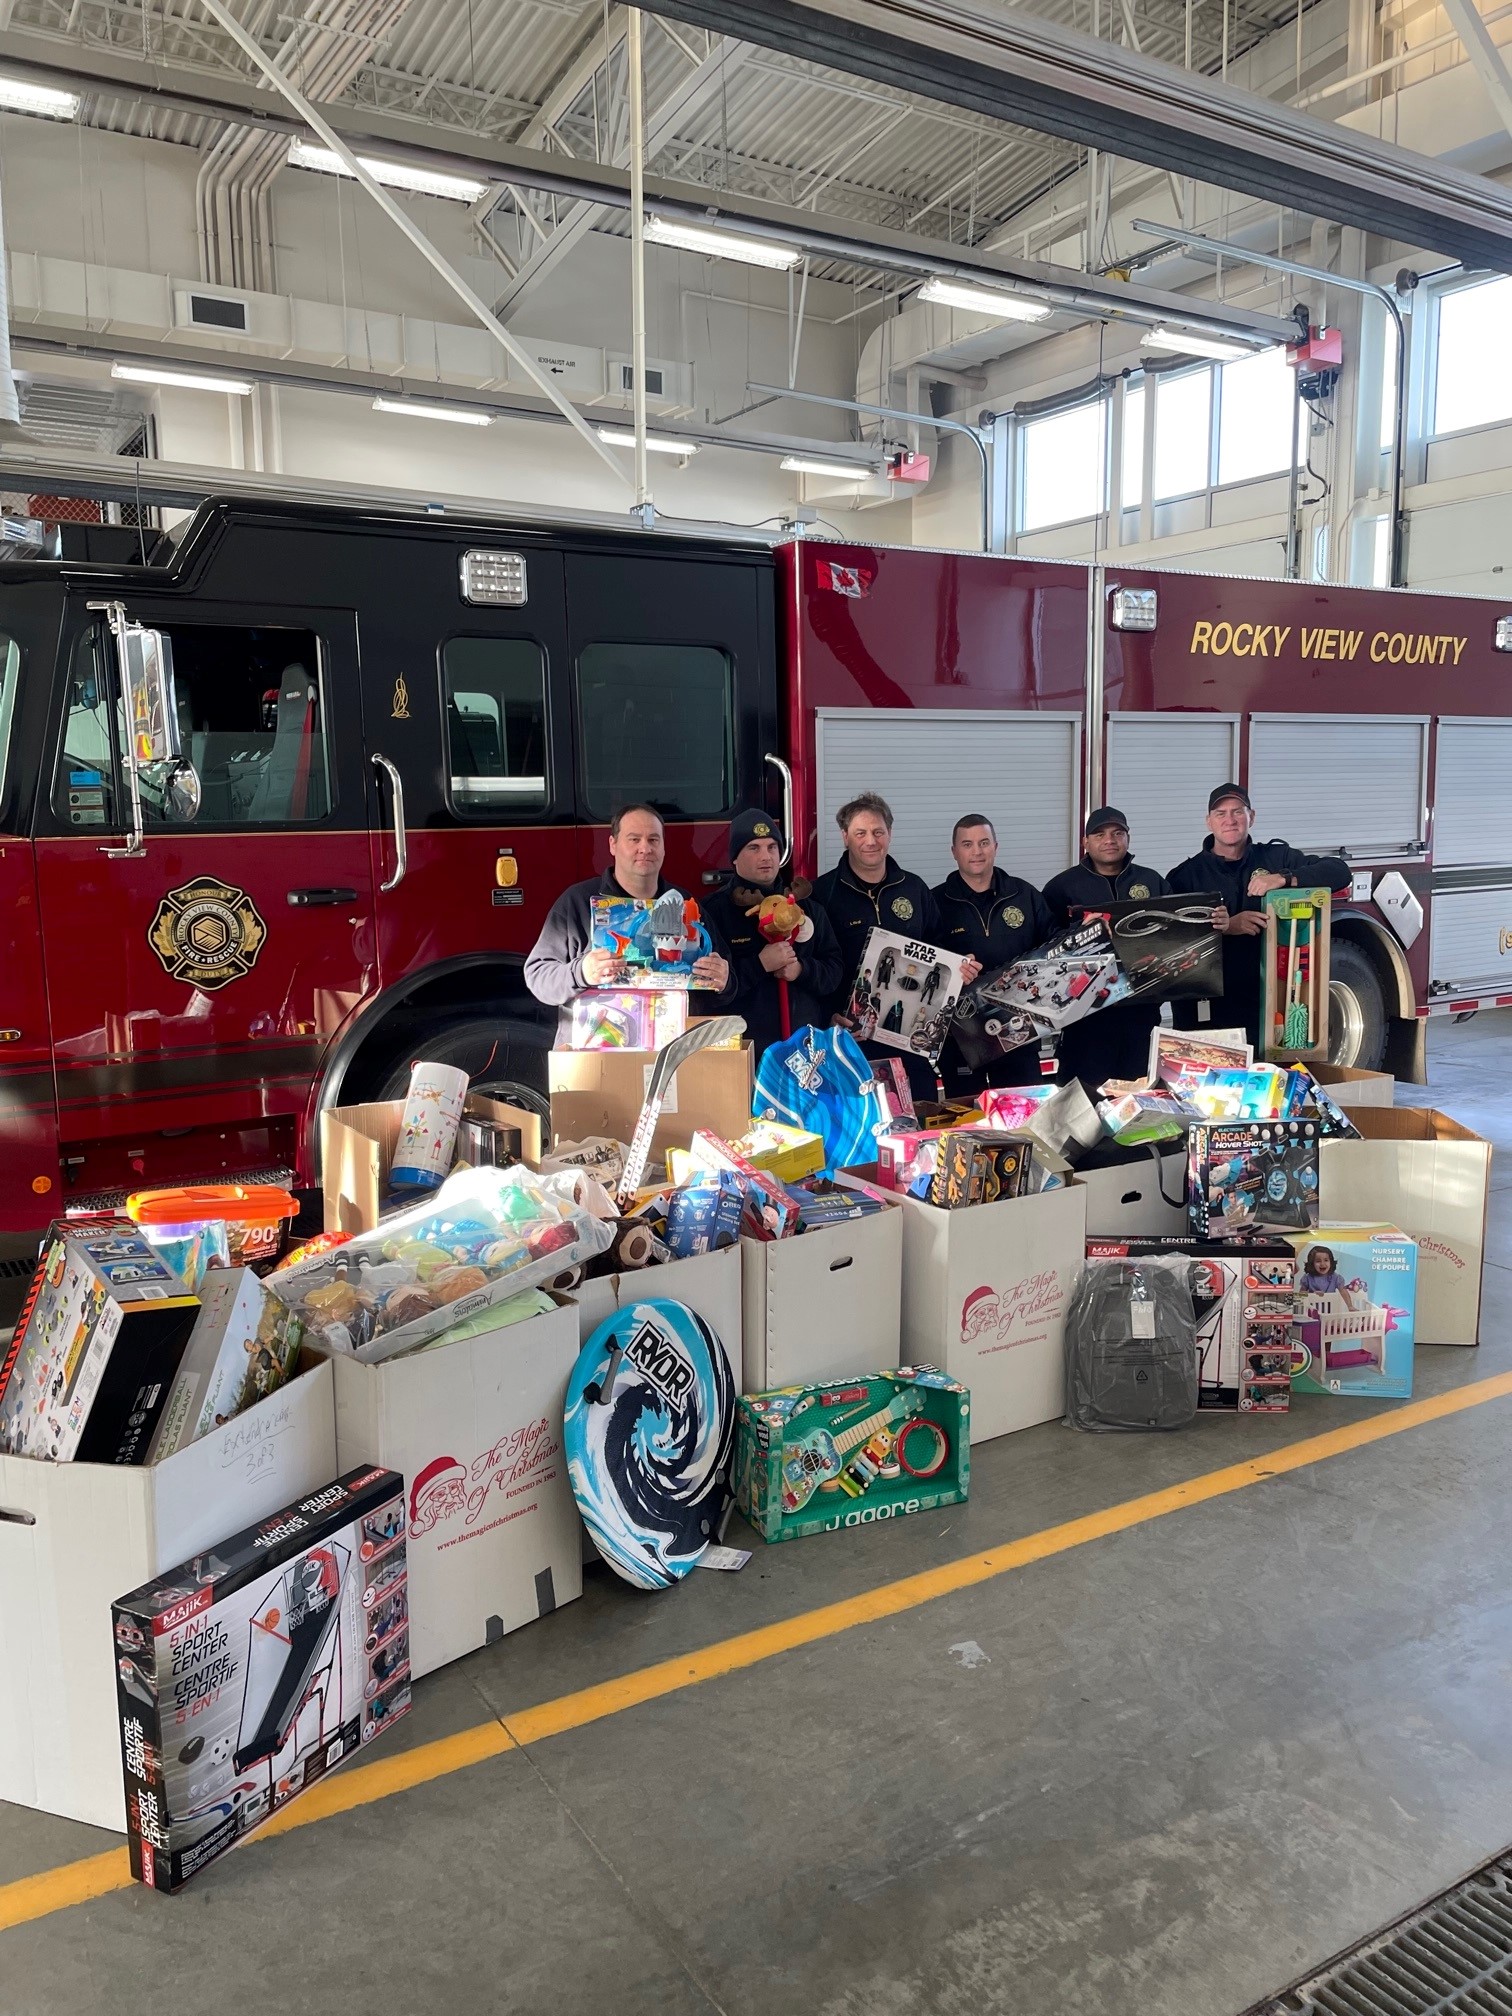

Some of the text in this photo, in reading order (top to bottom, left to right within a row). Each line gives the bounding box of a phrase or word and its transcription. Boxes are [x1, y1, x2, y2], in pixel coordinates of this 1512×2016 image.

[538, 356, 564, 366] EXHAUST
[1190, 621, 1468, 665] ROCKY VIEW COUNTY
[178, 904, 239, 939] ROCKY VIEW COUNTY
[181, 941, 238, 964] FIRE RESCUE
[903, 948, 936, 964] WARS
[904, 941, 937, 957] STAR
[1046, 923, 1102, 960] ALL STAR
[785, 1050, 823, 1096] RYR
[628, 1099, 662, 1201] SHERWOOD
[1211, 1131, 1253, 1142] ARCADE
[1215, 1140, 1263, 1149] HOVER SHOT
[618, 1103, 651, 1206] SHERWOOD
[722, 1201, 741, 1209] OREO
[240, 1226, 274, 1246] 790
[1092, 1247, 1121, 1256] MAJIK
[1418, 1236, 1466, 1269] Christmas
[1382, 1263, 1410, 1271] POUPÉE
[1003, 1270, 1057, 1308] The Magic
[1019, 1285, 1064, 1319] Christmas
[628, 1323, 693, 1407] RYDR
[163, 1378, 187, 1441] LADDERBALL
[178, 1389, 194, 1423] PLIANT
[471, 1418, 549, 1482] The Magic
[299, 1485, 342, 1512] CENTER
[465, 1437, 560, 1525] Of Christmas
[505, 1471, 557, 1500] FOUNDED IN 1983
[312, 1490, 348, 1515] SPORT
[253, 1515, 303, 1548] SPORTIF
[265, 1519, 309, 1548] CENTRE
[437, 1503, 538, 1551] www.themagicofchristmas.org
[163, 1595, 203, 1629] MAJIK
[170, 1614, 208, 1649] 5-IN-1
[171, 1621, 222, 1662] SPORT
[172, 1633, 228, 1676] CENTER
[174, 1652, 230, 1696] CENTRE
[175, 1661, 238, 1711] SPORTIF
[175, 1687, 221, 1725] 5-EN-1
[124, 1717, 137, 1774] CENTRE
[133, 1717, 146, 1782] SPORTIF
[138, 1789, 150, 1842] SPORT
[147, 1792, 162, 1850] CENTER
[144, 1852, 153, 1886] MAJIK
